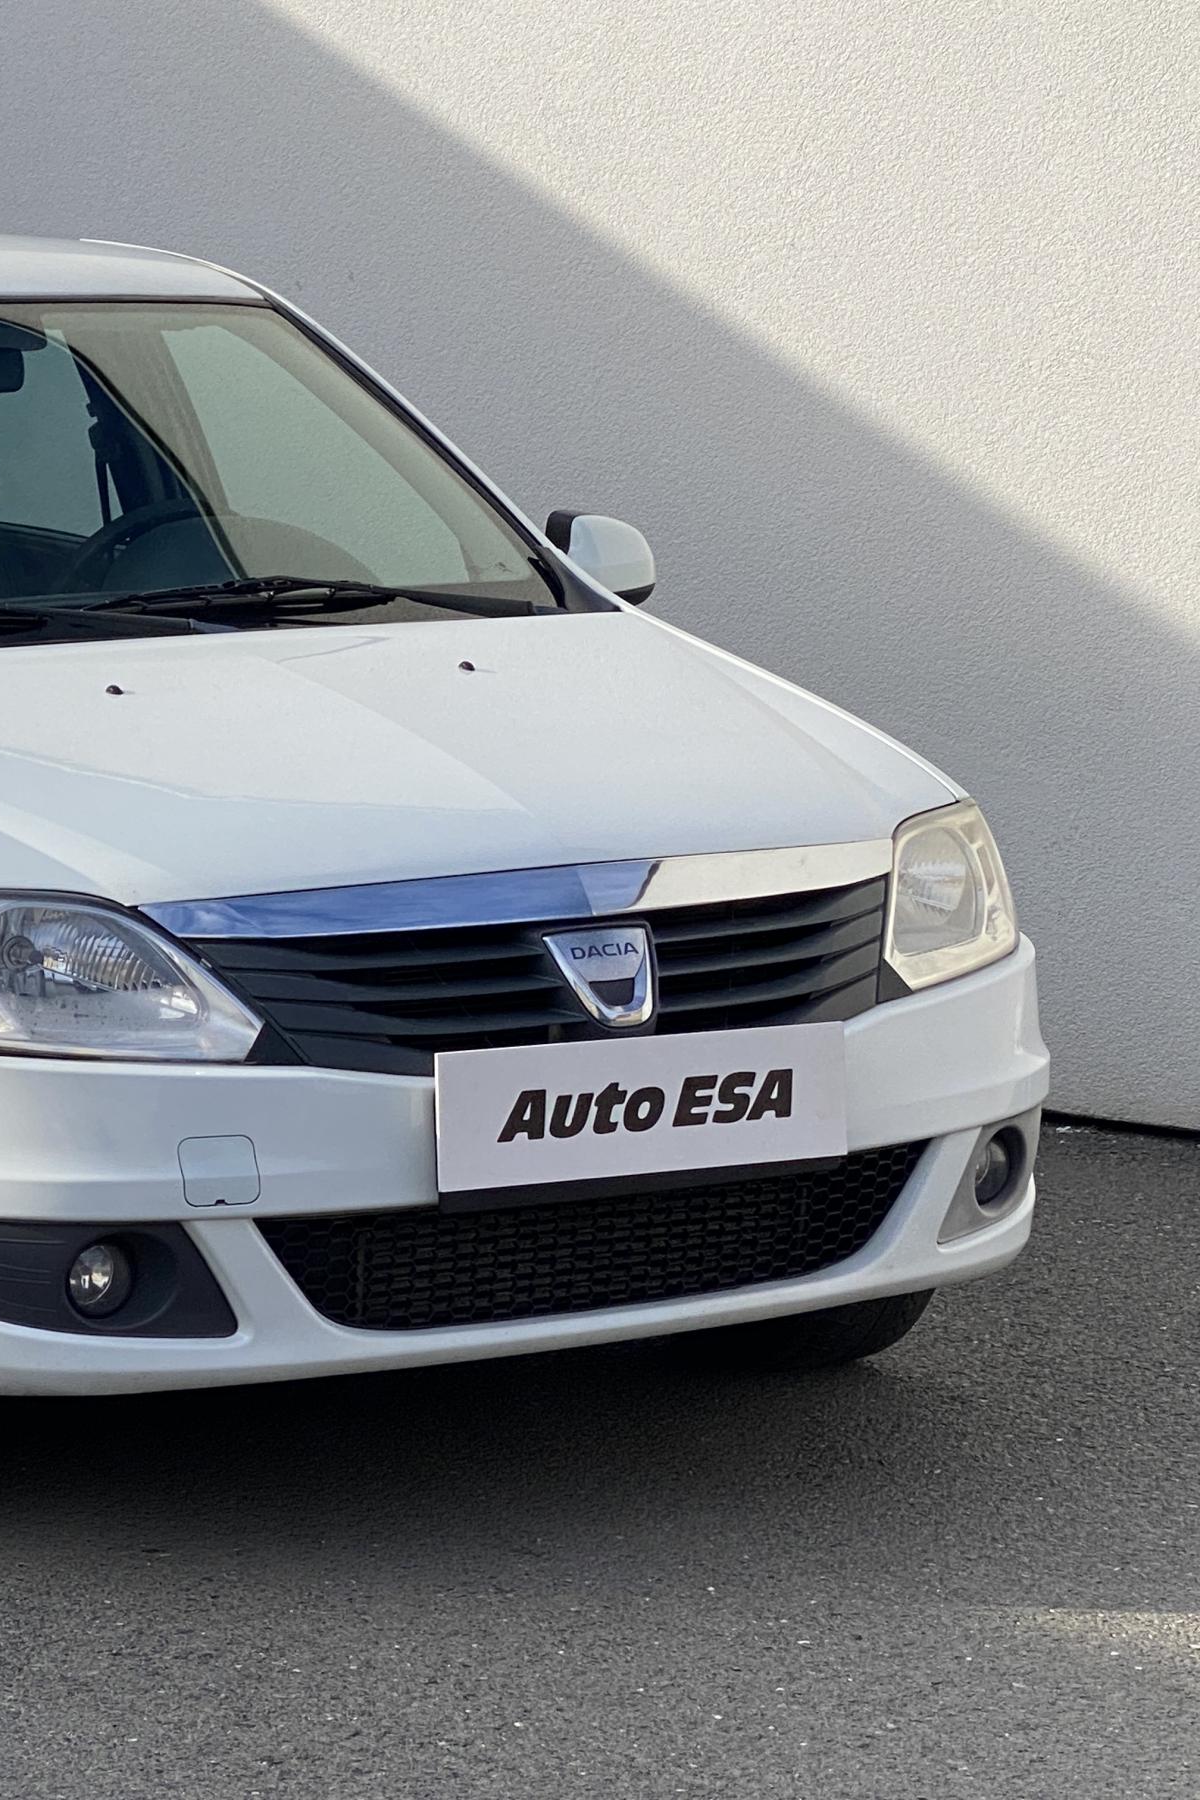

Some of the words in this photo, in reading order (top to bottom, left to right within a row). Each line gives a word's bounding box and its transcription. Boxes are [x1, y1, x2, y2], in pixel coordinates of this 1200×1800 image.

[571, 942, 639, 961] DACIA
[497, 1082, 665, 1142] Auto
[672, 1068, 793, 1127] ESA
